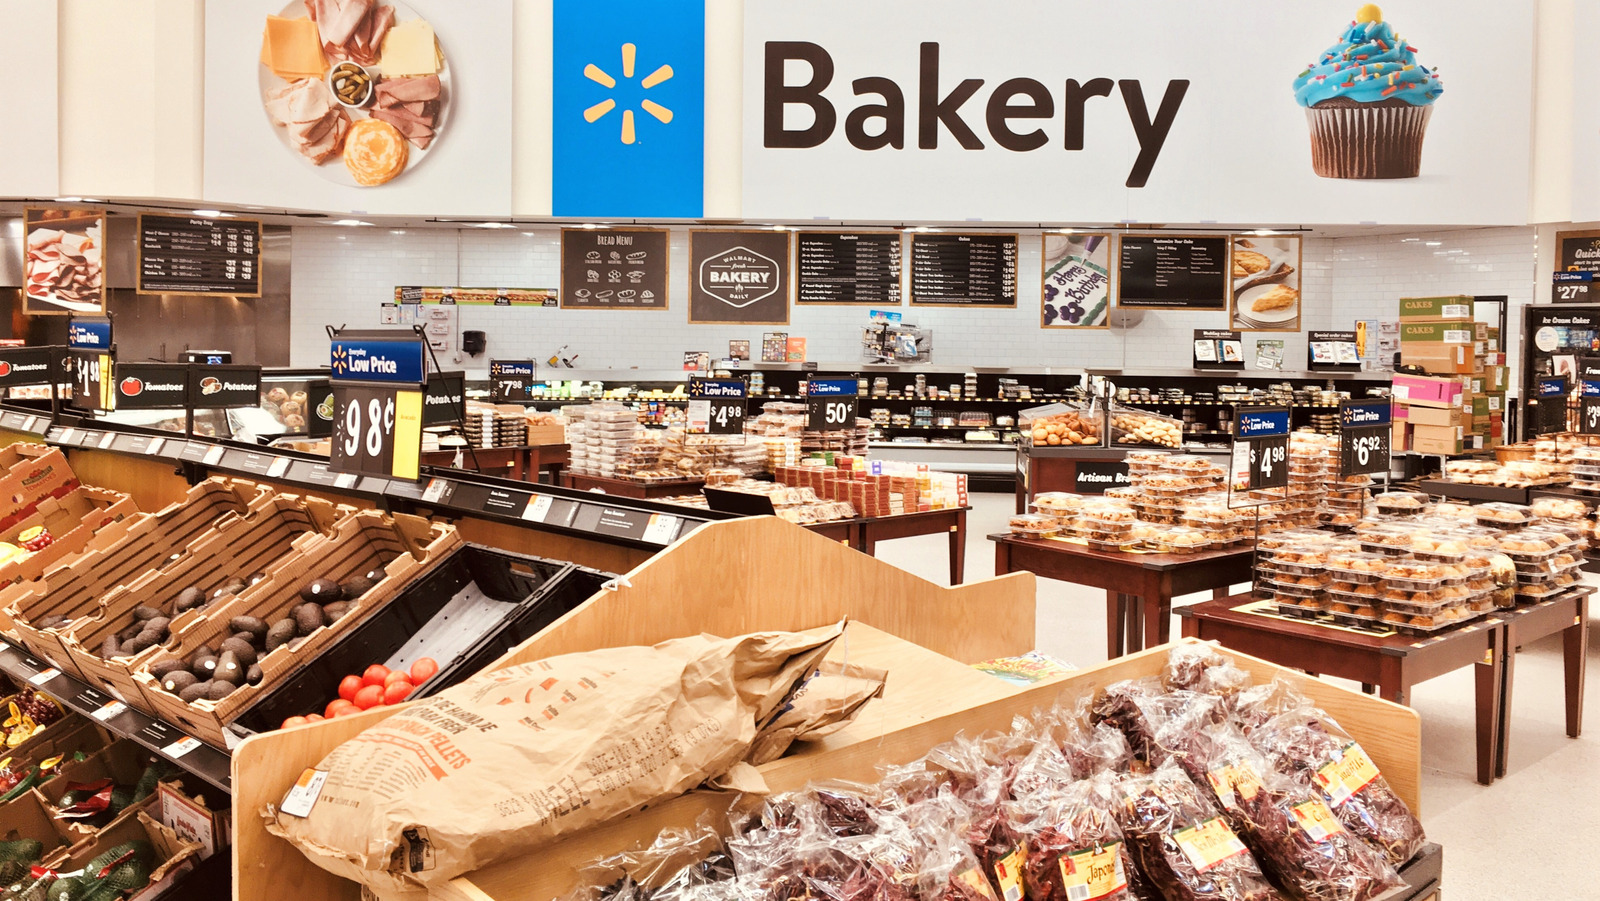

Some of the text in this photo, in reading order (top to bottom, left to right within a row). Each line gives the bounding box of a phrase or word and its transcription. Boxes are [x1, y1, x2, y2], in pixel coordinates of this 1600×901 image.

[764, 41, 1189, 187] Bakery
[597, 235, 633, 246] BREAD MENU
[722, 255, 757, 263] WALMART
[709, 271, 771, 284] BAKERY
[1405, 301, 1433, 309] CAKES
[1406, 327, 1434, 335] CAKES
[77, 332, 99, 345] Low Price
[348, 348, 367, 357] Everyday
[12, 363, 47, 372] Tomatoes
[348, 355, 397, 374] Low Price
[515, 367, 531, 375] Price
[144, 381, 184, 392] Tomatoes
[223, 381, 257, 392] Potatoes
[705, 386, 742, 396] Low Price
[1353, 411, 1380, 422] Low Price
[1250, 420, 1275, 430] Low Price
[1077, 472, 1113, 483] Artisan
[429, 732, 472, 770] PELLETS
